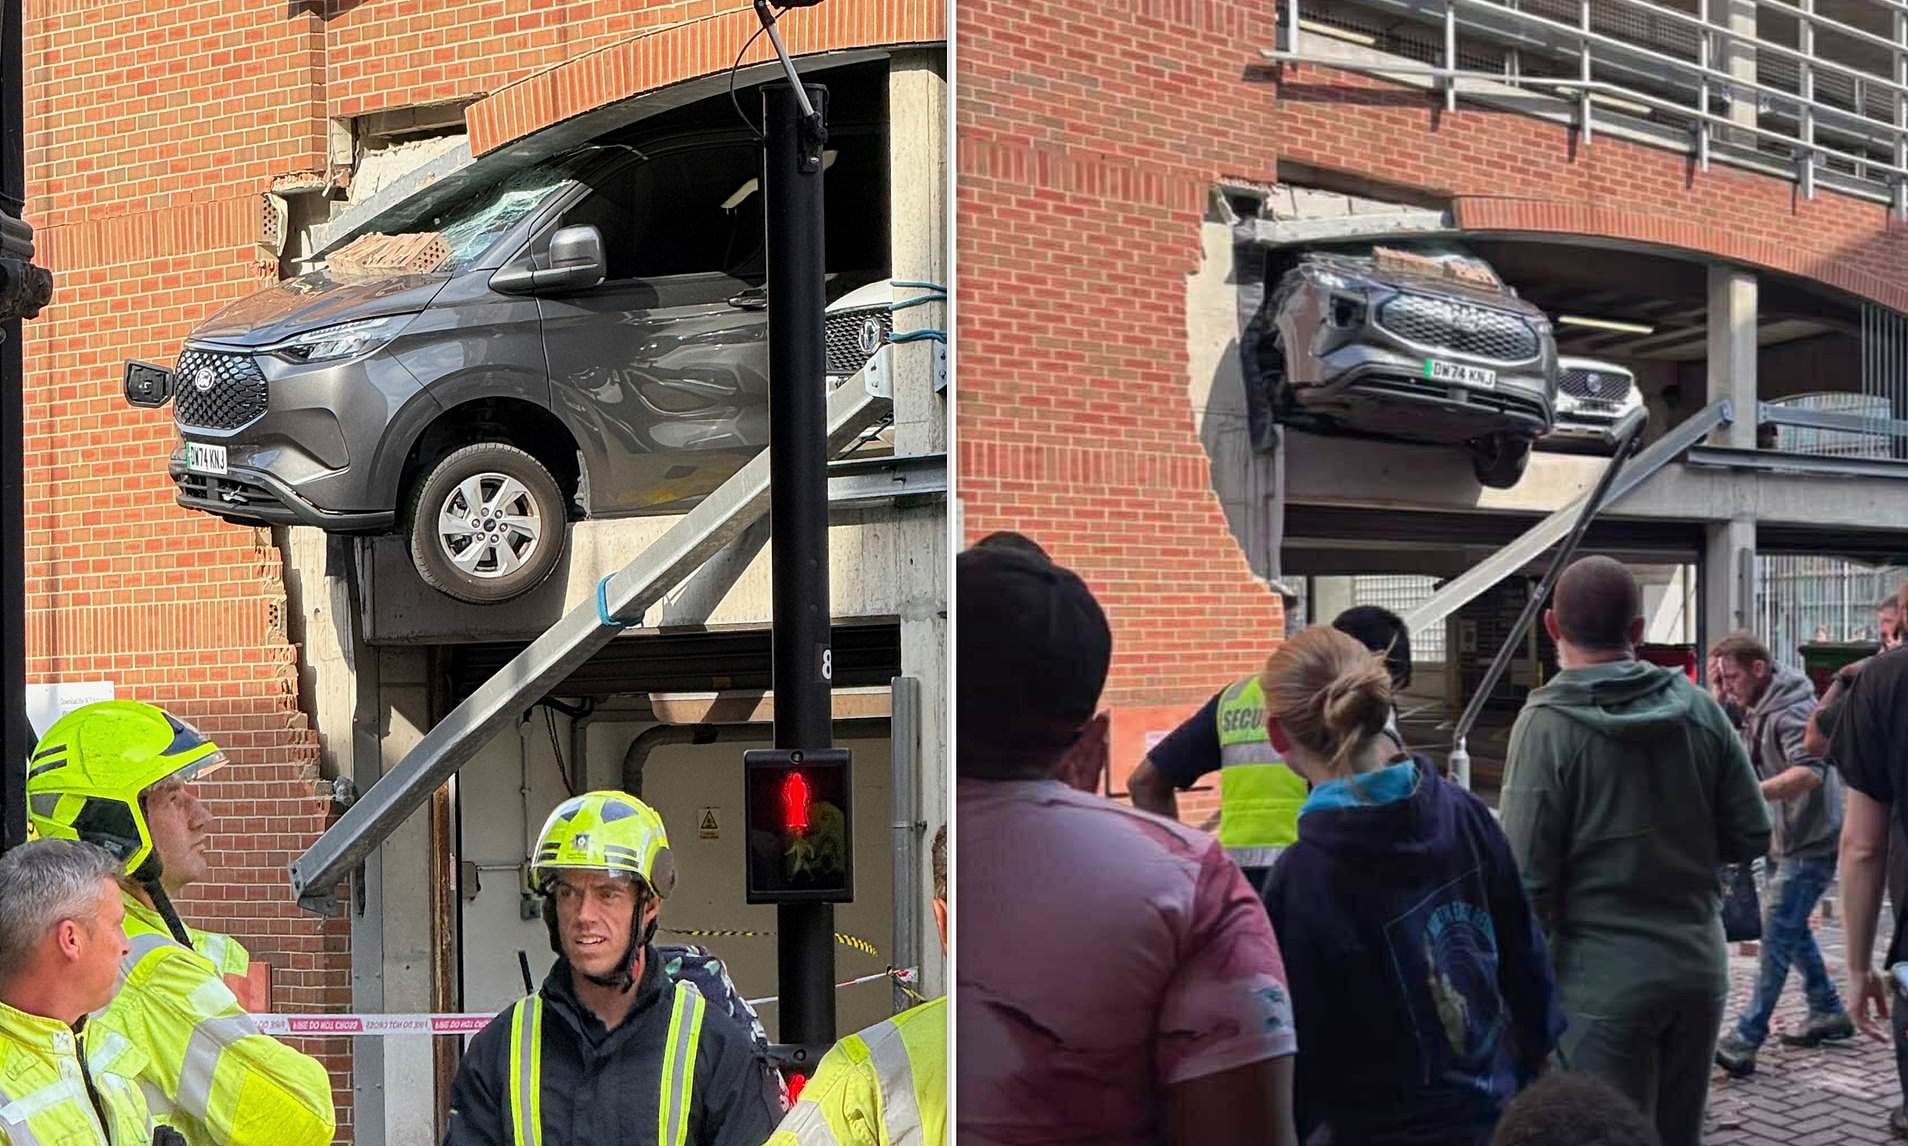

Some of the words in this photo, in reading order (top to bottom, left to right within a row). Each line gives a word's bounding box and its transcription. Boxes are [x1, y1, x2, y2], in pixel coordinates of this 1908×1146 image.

[1434, 362, 1466, 379] DW74
[1468, 369, 1494, 385] KNJ
[209, 448, 225, 470] KNJ
[812, 649, 832, 680] 8
[1223, 708, 1264, 732] SECU
